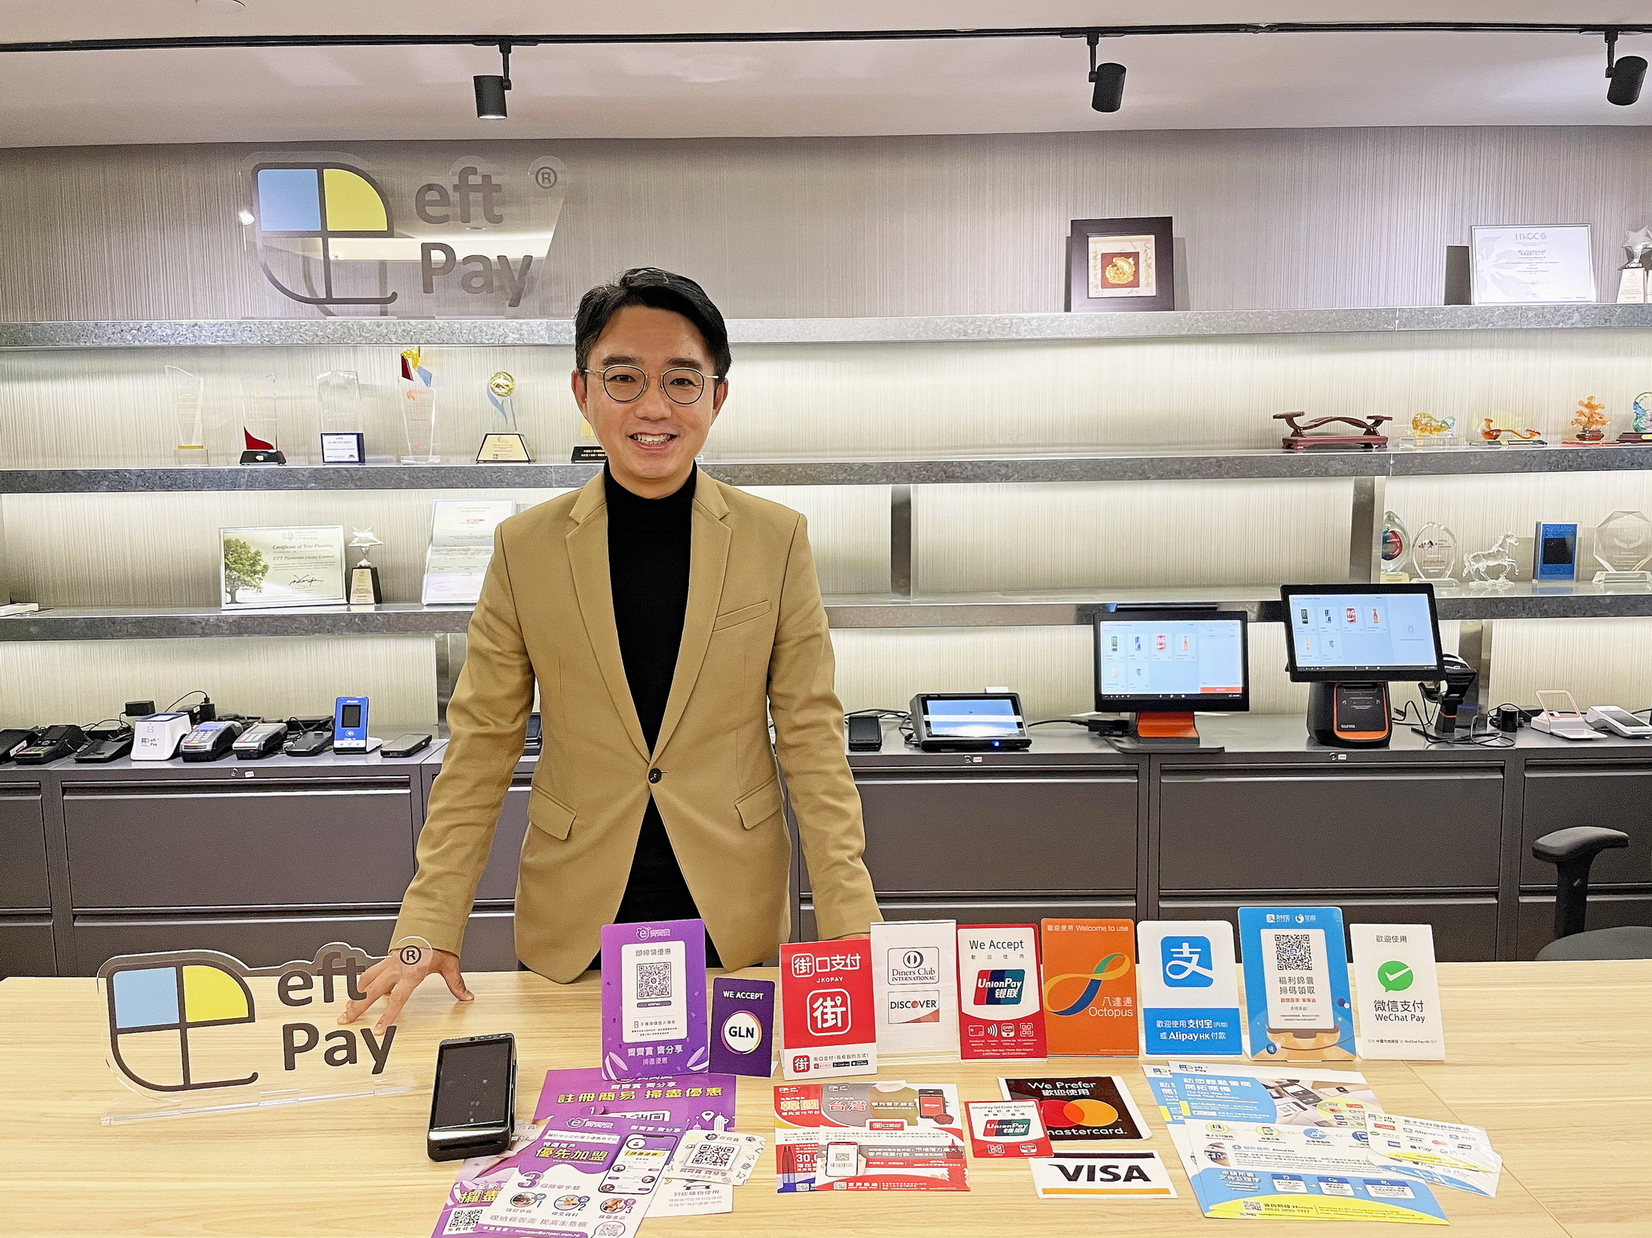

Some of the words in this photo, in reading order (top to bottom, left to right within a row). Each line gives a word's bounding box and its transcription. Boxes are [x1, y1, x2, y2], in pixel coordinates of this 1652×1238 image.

[414, 166, 504, 225] eft
[420, 242, 534, 308] Pay
[1075, 924, 1107, 932] Welcome
[1108, 924, 1116, 932] to
[968, 940, 986, 950] We
[988, 939, 1024, 951] Accept
[793, 953, 862, 975] 街口支付
[891, 968, 917, 977] Diners
[917, 967, 936, 976] Club
[277, 951, 367, 1007] eft
[815, 976, 844, 984] JKOPAY
[977, 978, 1023, 990] UnionPay
[722, 990, 734, 998] WE
[735, 991, 765, 1000] ACCEPT
[890, 1000, 937, 1010] DISCOVER
[1373, 999, 1424, 1013] 微信支付
[812, 995, 847, 1029] 街
[1088, 1006, 1134, 1018] Octopus
[1374, 1013, 1409, 1022] WeChat
[1410, 1013, 1426, 1024] Pay
[728, 1025, 755, 1039] GLN
[281, 1022, 397, 1076] Pay
[1027, 1081, 1053, 1090] We
[1058, 1080, 1098, 1089] Prefer
[986, 1122, 1029, 1130] UnionPay
[1047, 1163, 1152, 1183] VISA
[517, 1171, 544, 1189] 3
